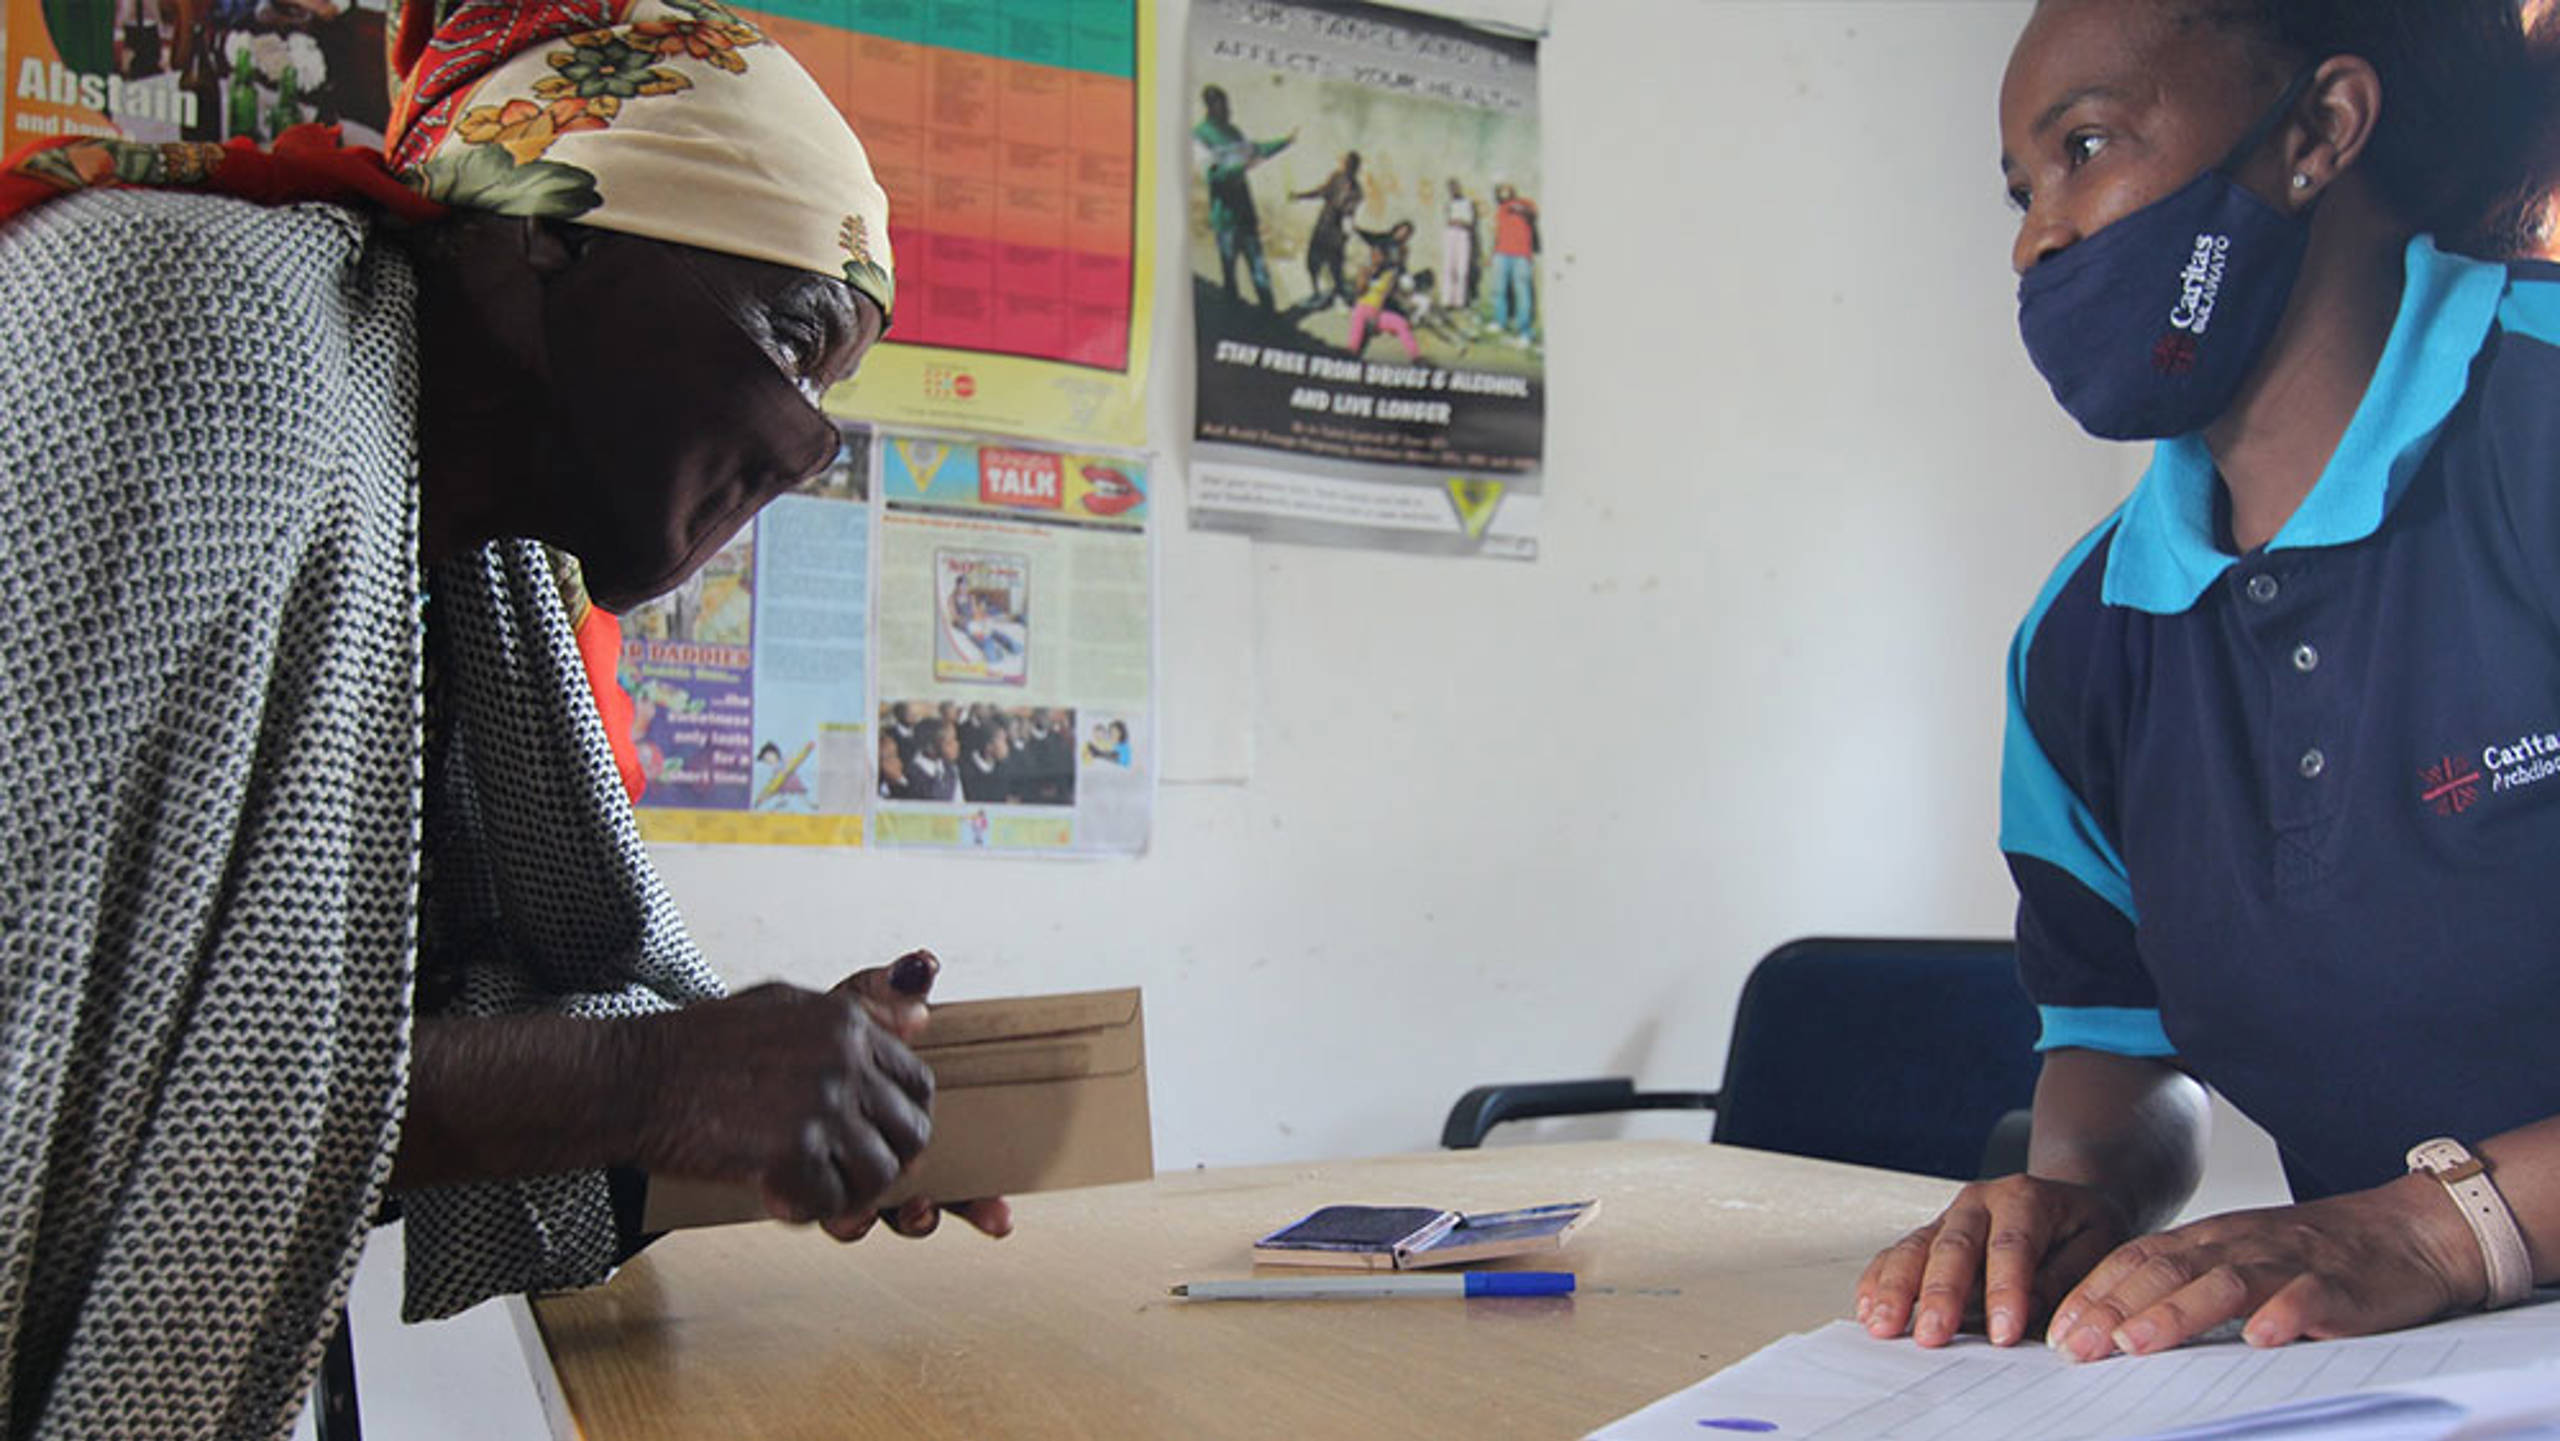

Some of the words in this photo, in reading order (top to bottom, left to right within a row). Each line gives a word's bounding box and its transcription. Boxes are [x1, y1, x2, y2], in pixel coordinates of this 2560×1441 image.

[17, 57, 197, 128] Abstain
[16, 112, 58, 136] and
[2171, 234, 2213, 328] Caritas
[1215, 339, 1260, 366] STAY
[1261, 347, 1307, 375] FREE
[1309, 355, 1363, 383] FROM
[1364, 363, 1430, 389] DRUGS
[1450, 370, 1528, 398] ALCOHOL
[1290, 387, 1330, 412] AND
[1332, 392, 1373, 418] LIVE
[1375, 398, 1451, 427] LONGER
[987, 468, 1056, 497] TALK
